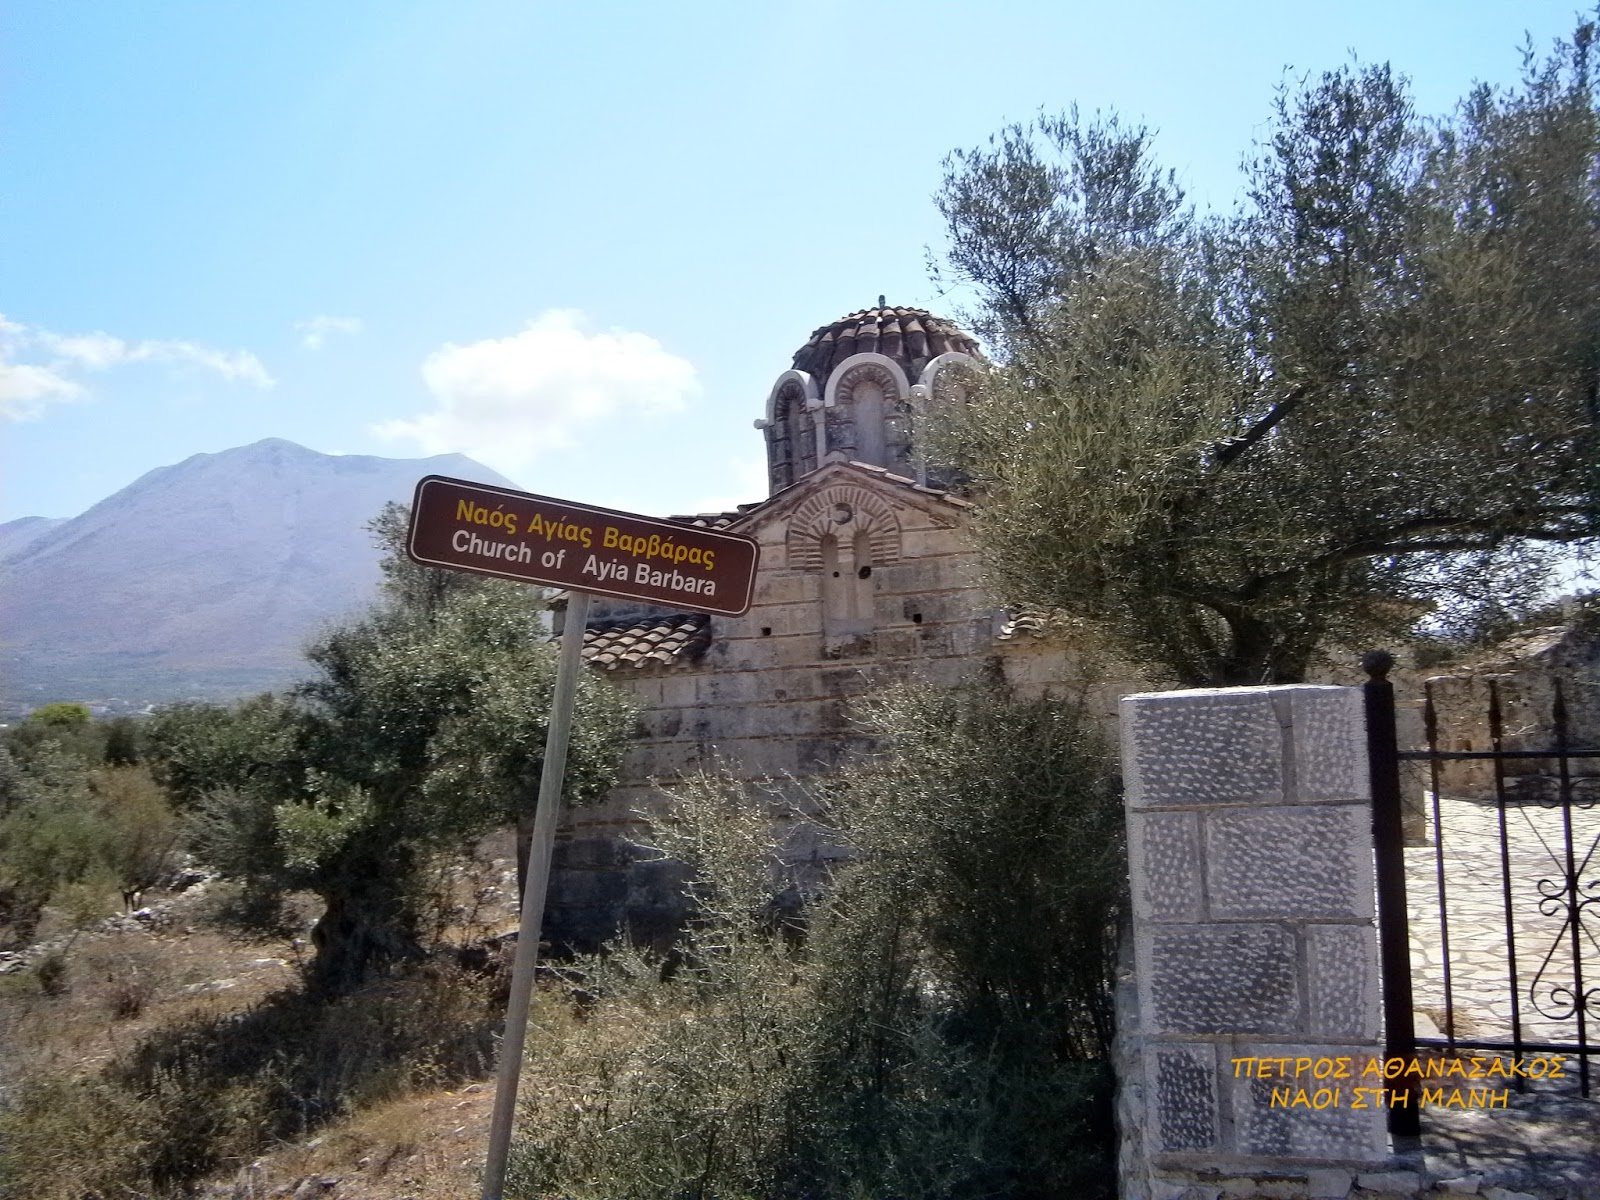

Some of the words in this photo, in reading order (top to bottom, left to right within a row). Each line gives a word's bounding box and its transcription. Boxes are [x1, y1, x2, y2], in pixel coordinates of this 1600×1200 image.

[451, 529, 532, 565] Church
[541, 549, 566, 569] of
[581, 554, 629, 581] Ayia
[634, 562, 717, 597] Barbara
[456, 499, 517, 534] Ναός
[528, 514, 592, 549] Αγίας
[602, 526, 715, 571] Βαρβάρας
